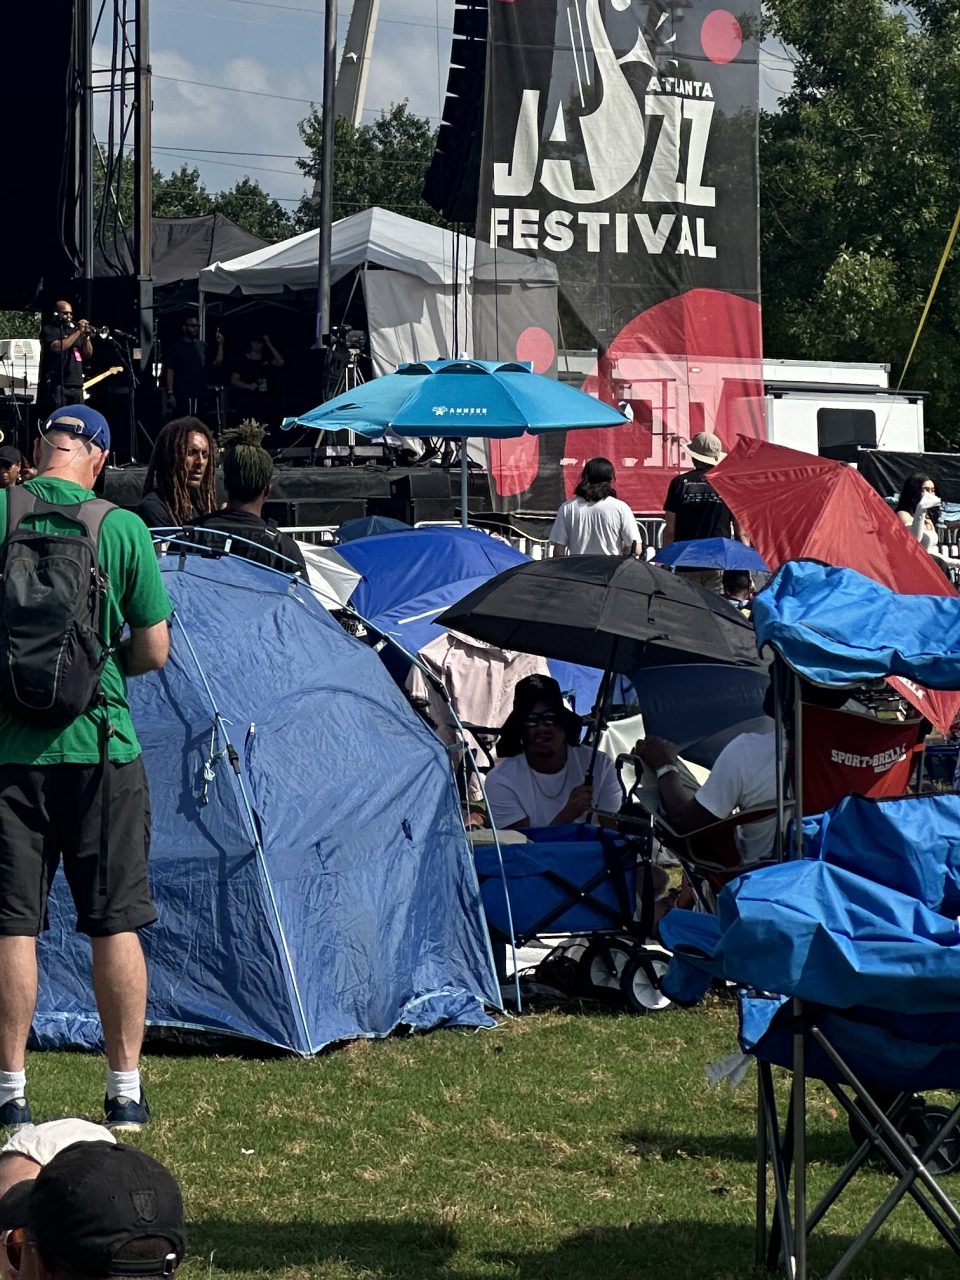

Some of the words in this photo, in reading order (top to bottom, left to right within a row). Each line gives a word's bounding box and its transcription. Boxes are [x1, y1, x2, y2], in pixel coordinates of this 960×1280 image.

[646, 75, 714, 98] ATLANTA
[492, 88, 716, 208] JAZZ
[489, 207, 717, 258] FESTIVAL
